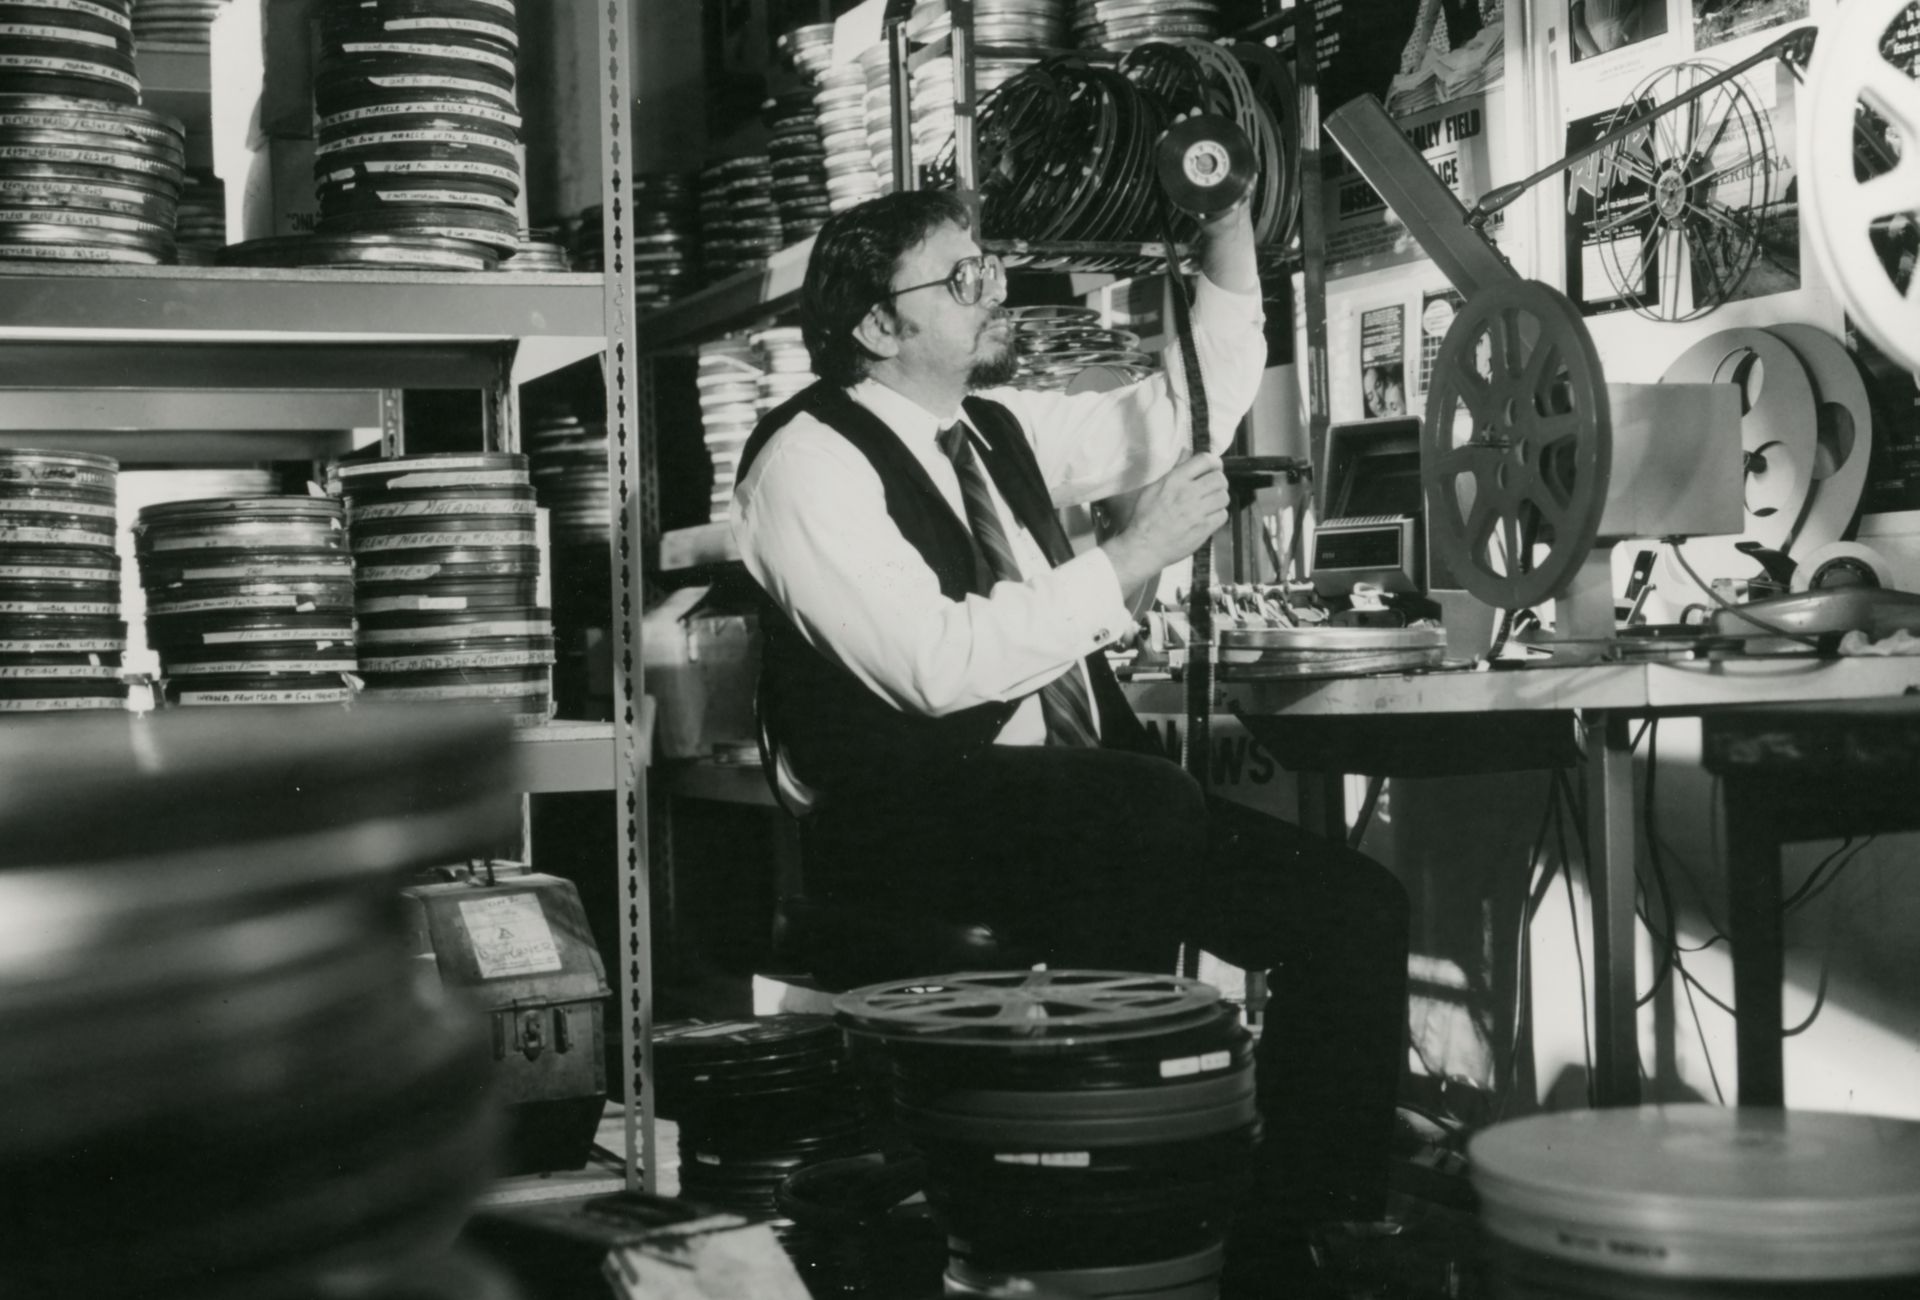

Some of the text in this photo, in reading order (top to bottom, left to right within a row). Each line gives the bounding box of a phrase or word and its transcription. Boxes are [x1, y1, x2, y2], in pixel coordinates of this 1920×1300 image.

[1445, 108, 1481, 144] FIELD
[1716, 154, 1792, 186] ERICANA
[1145, 718, 1275, 786] NWS
